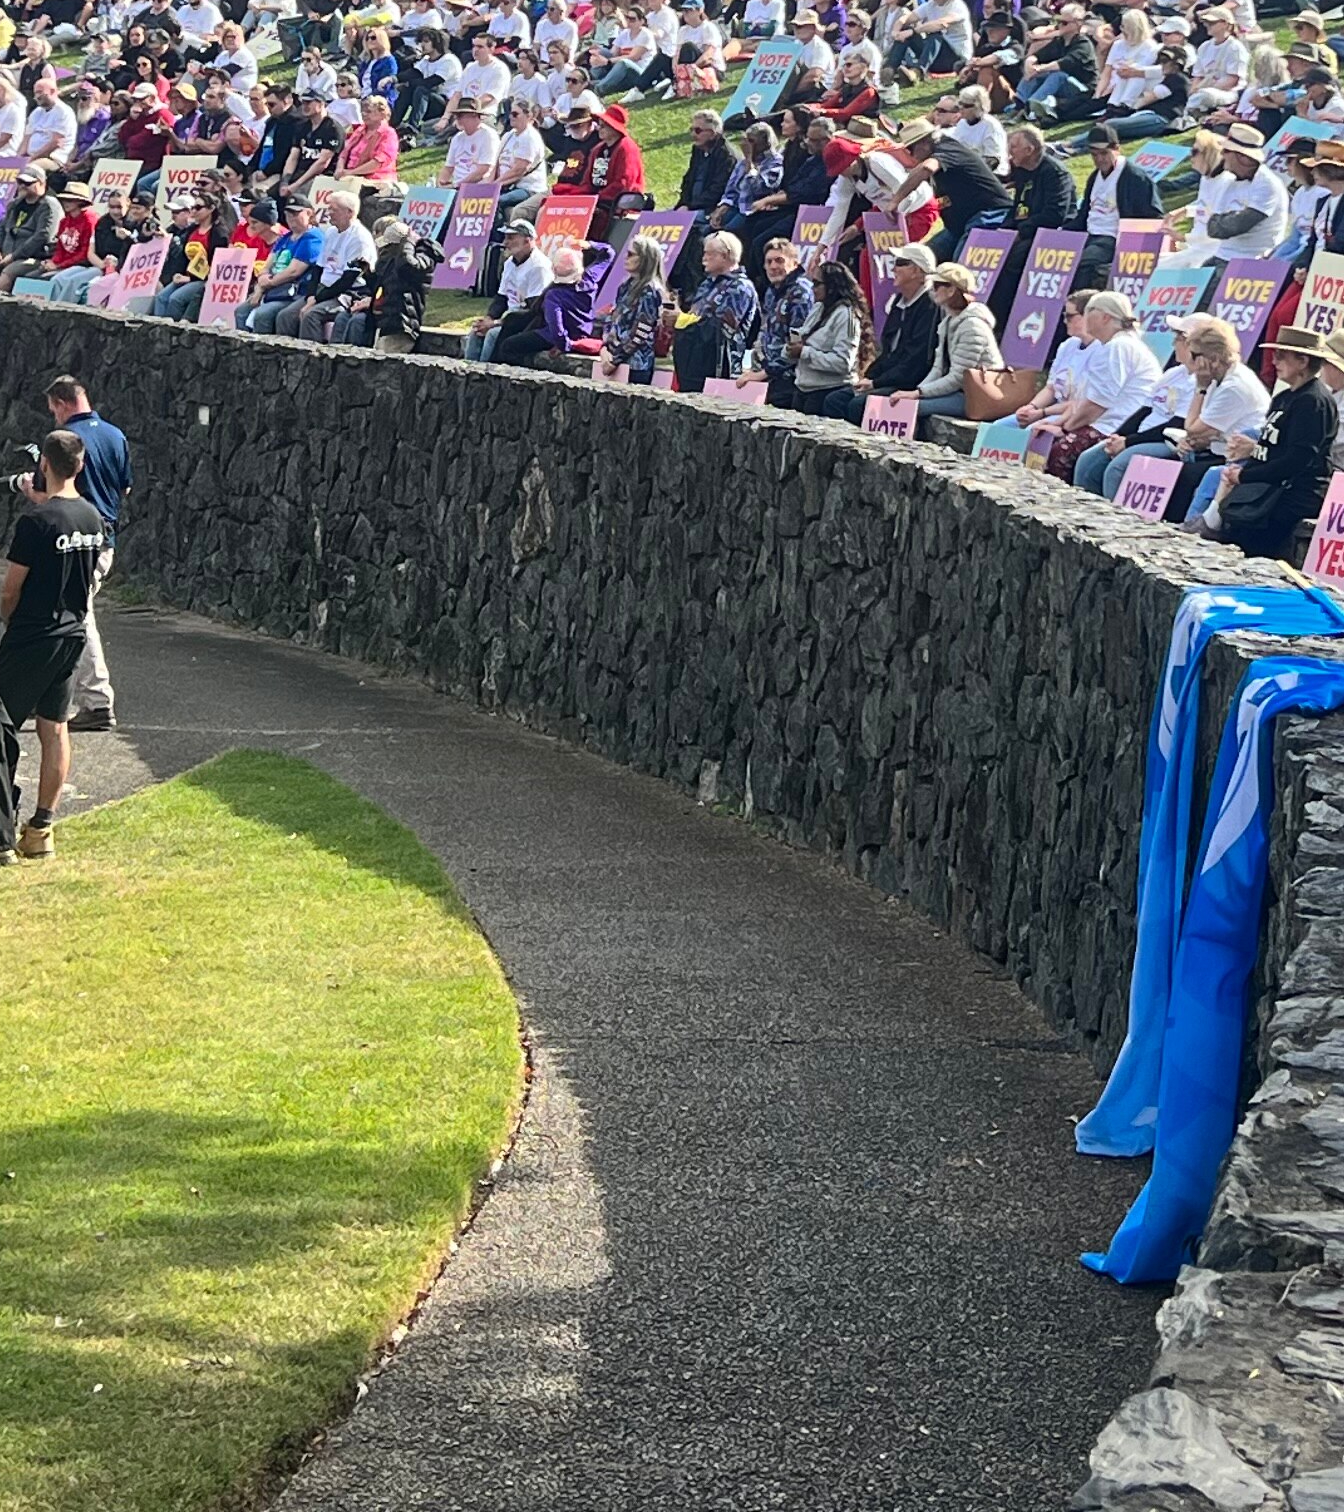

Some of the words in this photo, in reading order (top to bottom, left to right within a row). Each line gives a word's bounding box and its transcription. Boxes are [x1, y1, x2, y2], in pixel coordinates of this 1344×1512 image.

[757, 54, 793, 67] VOTE
[750, 69, 785, 84] YES!
[97, 171, 132, 186] VOTE
[168, 170, 202, 184] VOT
[90, 188, 110, 204] YE
[408, 200, 445, 217] VOTE
[460, 198, 493, 215] VOTE
[456, 216, 487, 236] YES!
[129, 251, 161, 270] VOTE
[873, 254, 895, 279] YE
[967, 247, 1004, 269] VOTE
[1034, 248, 1076, 271] VOTE
[1119, 253, 1154, 275] VOTE
[123, 270, 155, 291] YES!
[215, 263, 247, 281] VOTE
[211, 284, 243, 304] YES!
[1026, 271, 1067, 299] YES!
[1225, 277, 1275, 302] VOTE
[1147, 287, 1197, 306] VOTE
[1215, 302, 1262, 331] YES!
[1305, 302, 1343, 334] YES!
[869, 419, 908, 437] VOTE
[1122, 481, 1165, 512] VOTE
